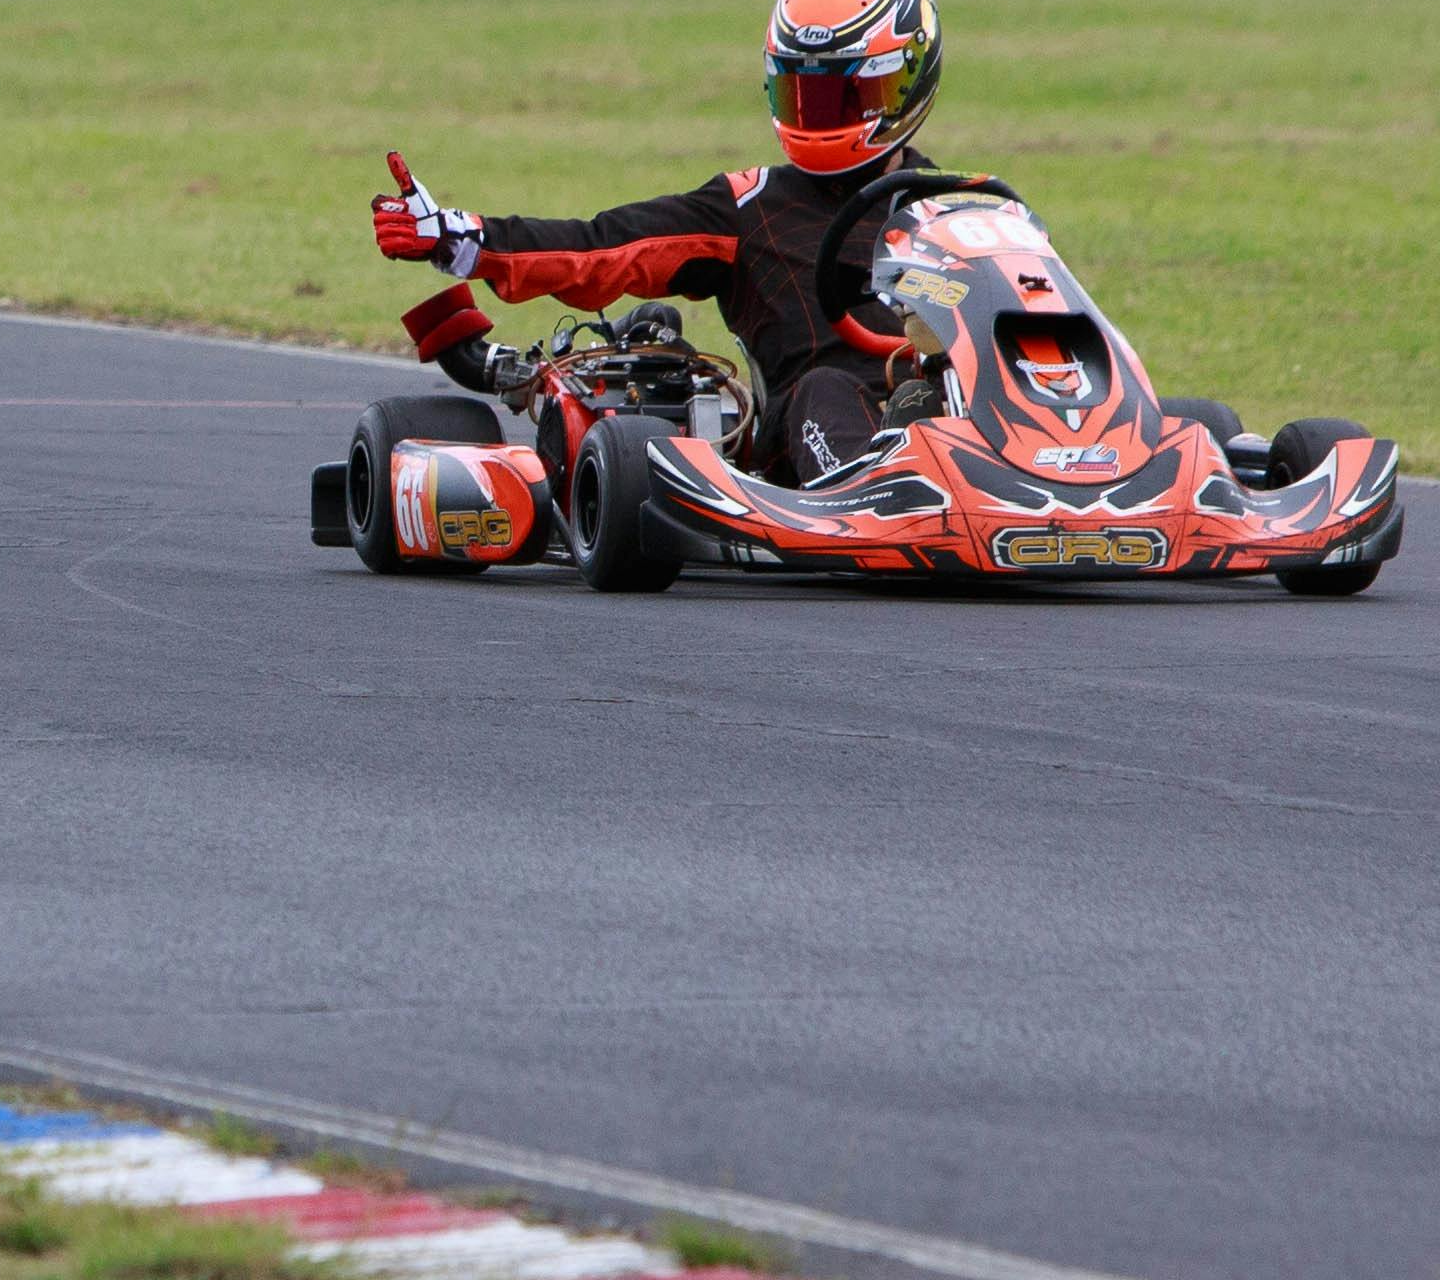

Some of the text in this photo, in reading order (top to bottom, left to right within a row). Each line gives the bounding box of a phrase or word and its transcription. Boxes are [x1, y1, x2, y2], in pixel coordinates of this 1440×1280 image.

[801, 25, 830, 41] Arai
[947, 216, 1046, 250] 66
[894, 267, 970, 310] CRG
[396, 465, 429, 551] 66
[438, 509, 512, 548] CRG
[1008, 534, 1155, 566] CRG
